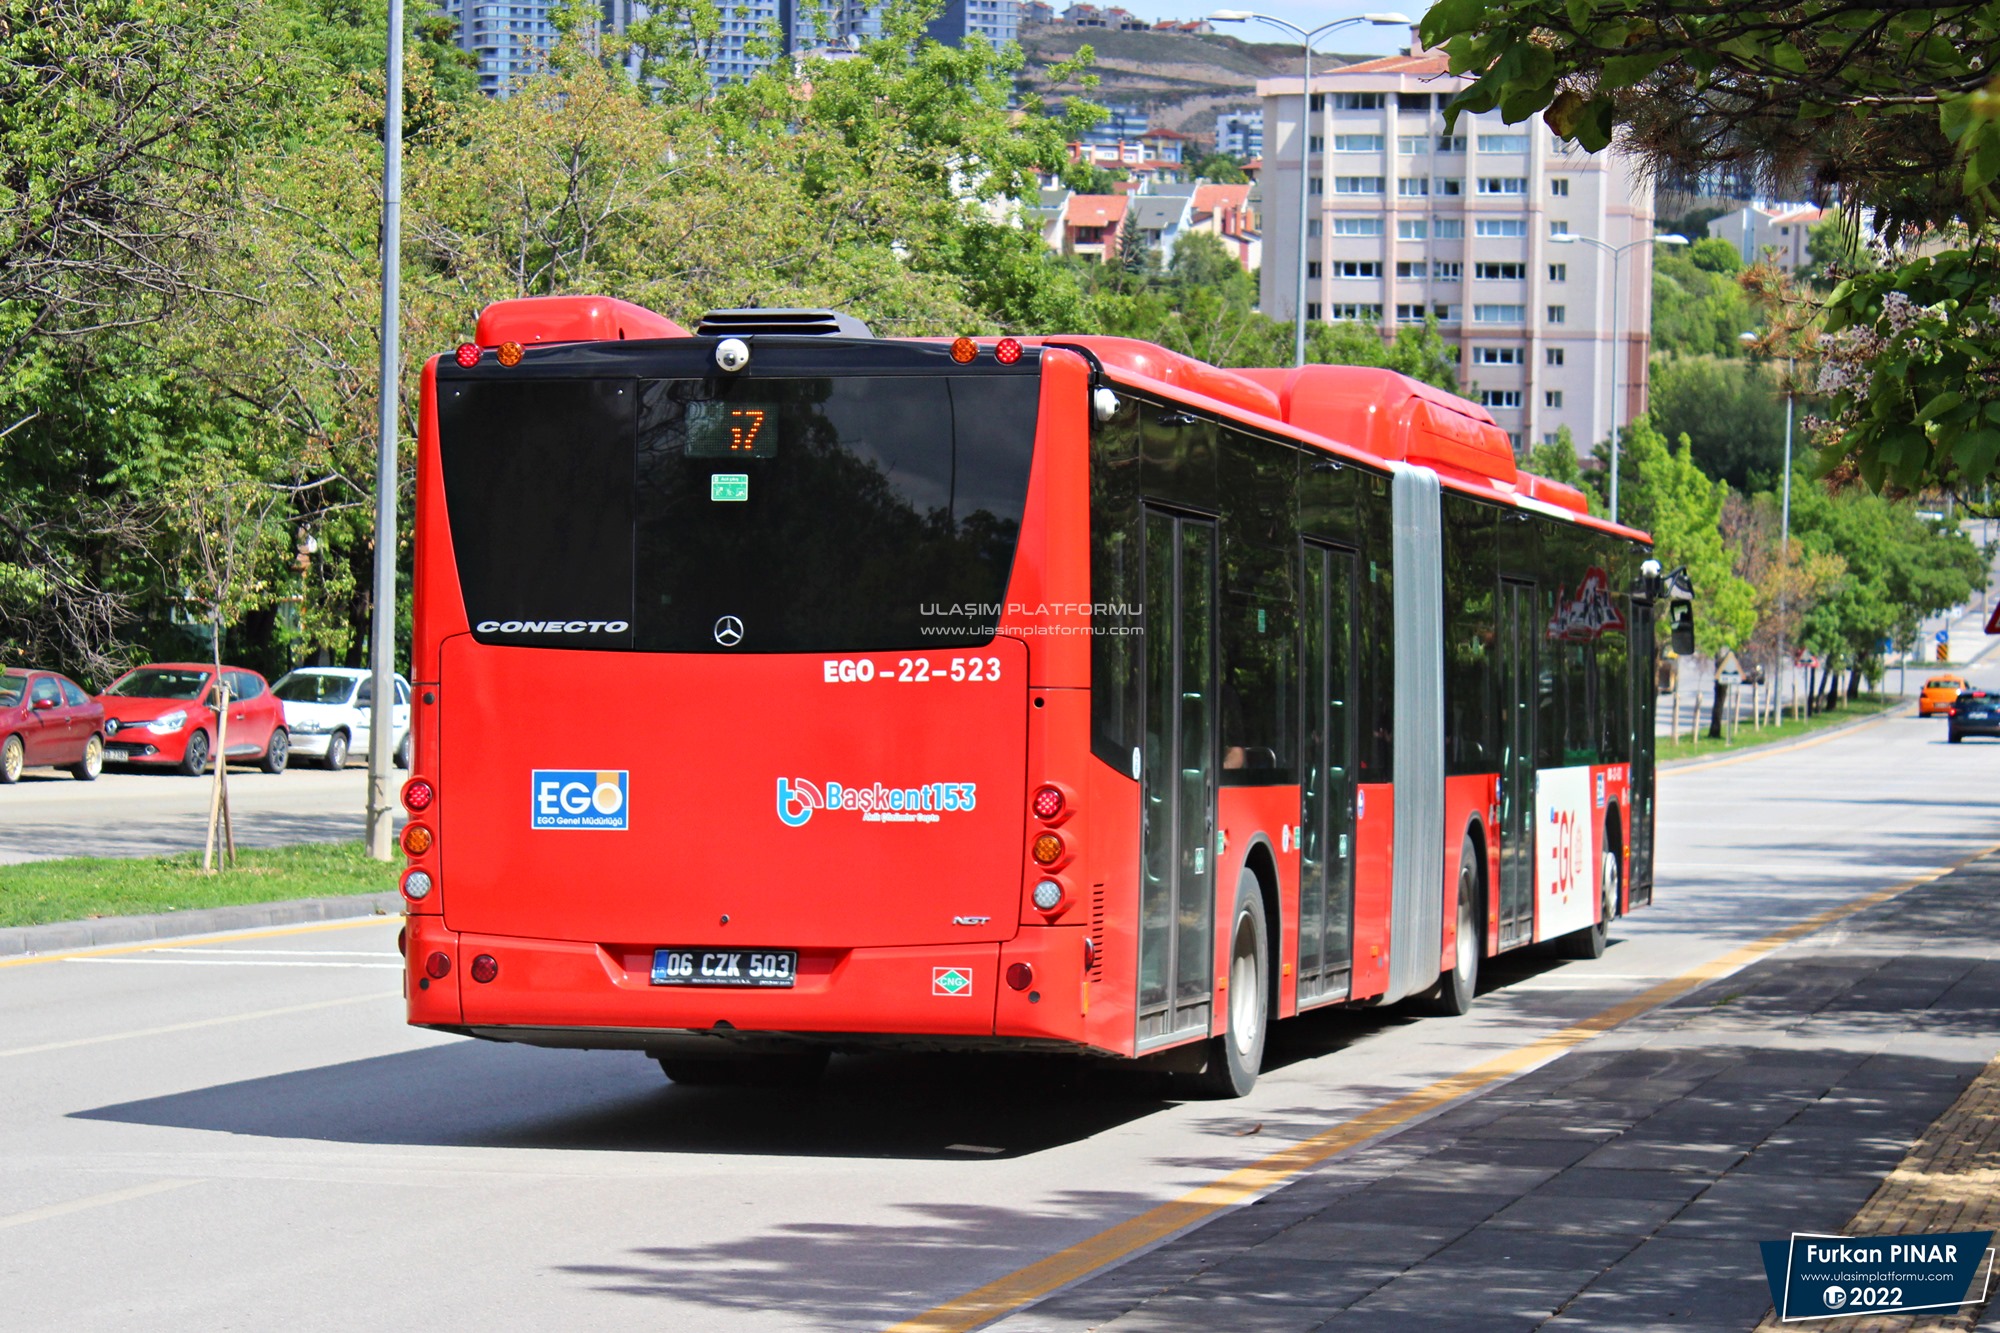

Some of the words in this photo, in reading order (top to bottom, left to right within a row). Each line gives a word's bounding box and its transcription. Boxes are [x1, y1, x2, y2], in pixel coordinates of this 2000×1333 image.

[476, 621, 629, 633] CONECTO
[538, 782, 623, 814] EGO
[826, 782, 976, 812] Başkent153
[537, 817, 555, 825] EGO
[557, 817, 580, 825] Genel
[582, 817, 623, 827] Müdürlüğü
[667, 953, 693, 976] 06
[701, 954, 742, 977] CZK
[749, 954, 790, 978] 503
[941, 978, 962, 987] CNG
